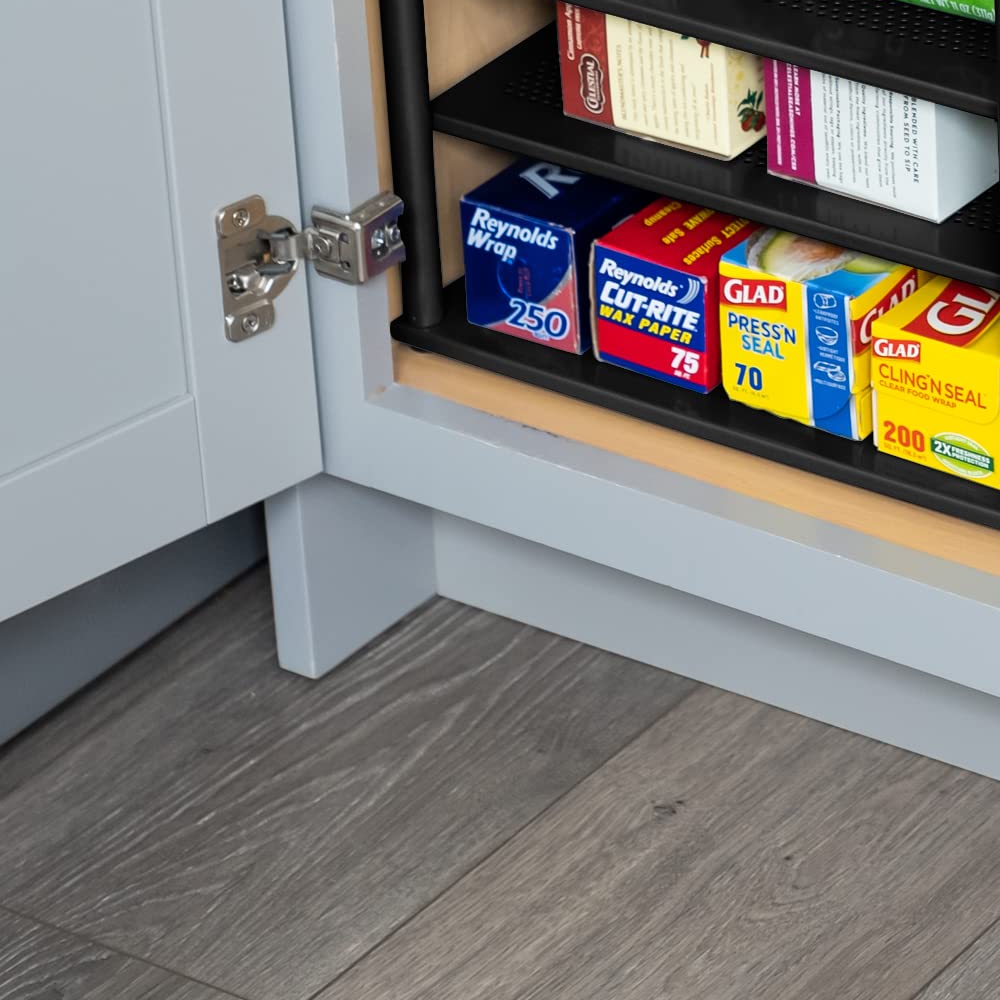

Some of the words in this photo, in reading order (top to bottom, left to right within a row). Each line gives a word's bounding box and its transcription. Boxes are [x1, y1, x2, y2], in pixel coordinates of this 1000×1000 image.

[960, 1, 971, 13] OZ
[586, 60, 600, 109] CELESTIAL
[904, 146, 910, 158] TO
[912, 162, 920, 184] CARE
[470, 207, 559, 250] Reynolds
[644, 202, 682, 227] Cleanup
[467, 228, 517, 263] Wrap
[661, 228, 685, 245] Safe
[683, 236, 722, 266] Surfaces
[599, 258, 679, 298] Reynolds
[723, 278, 784, 304] GLAD
[506, 298, 570, 339] 250
[600, 281, 701, 331] CUT-RITE
[927, 288, 1000, 335] GL
[599, 304, 635, 326] WAX
[638, 318, 692, 345] PAPER
[727, 312, 797, 345] PRESS'N
[670, 346, 700, 375] 75
[741, 335, 785, 360] SEAL
[873, 339, 920, 359] GLAD
[734, 362, 763, 391] 70
[879, 380, 905, 394] CLEAR
[906, 387, 931, 401] FOOD
[932, 395, 957, 409] WRAP
[945, 383, 987, 410] SEAL
[883, 420, 926, 453] 200
[933, 440, 952, 457] 2X
[951, 446, 990, 464] FRESHNESS
